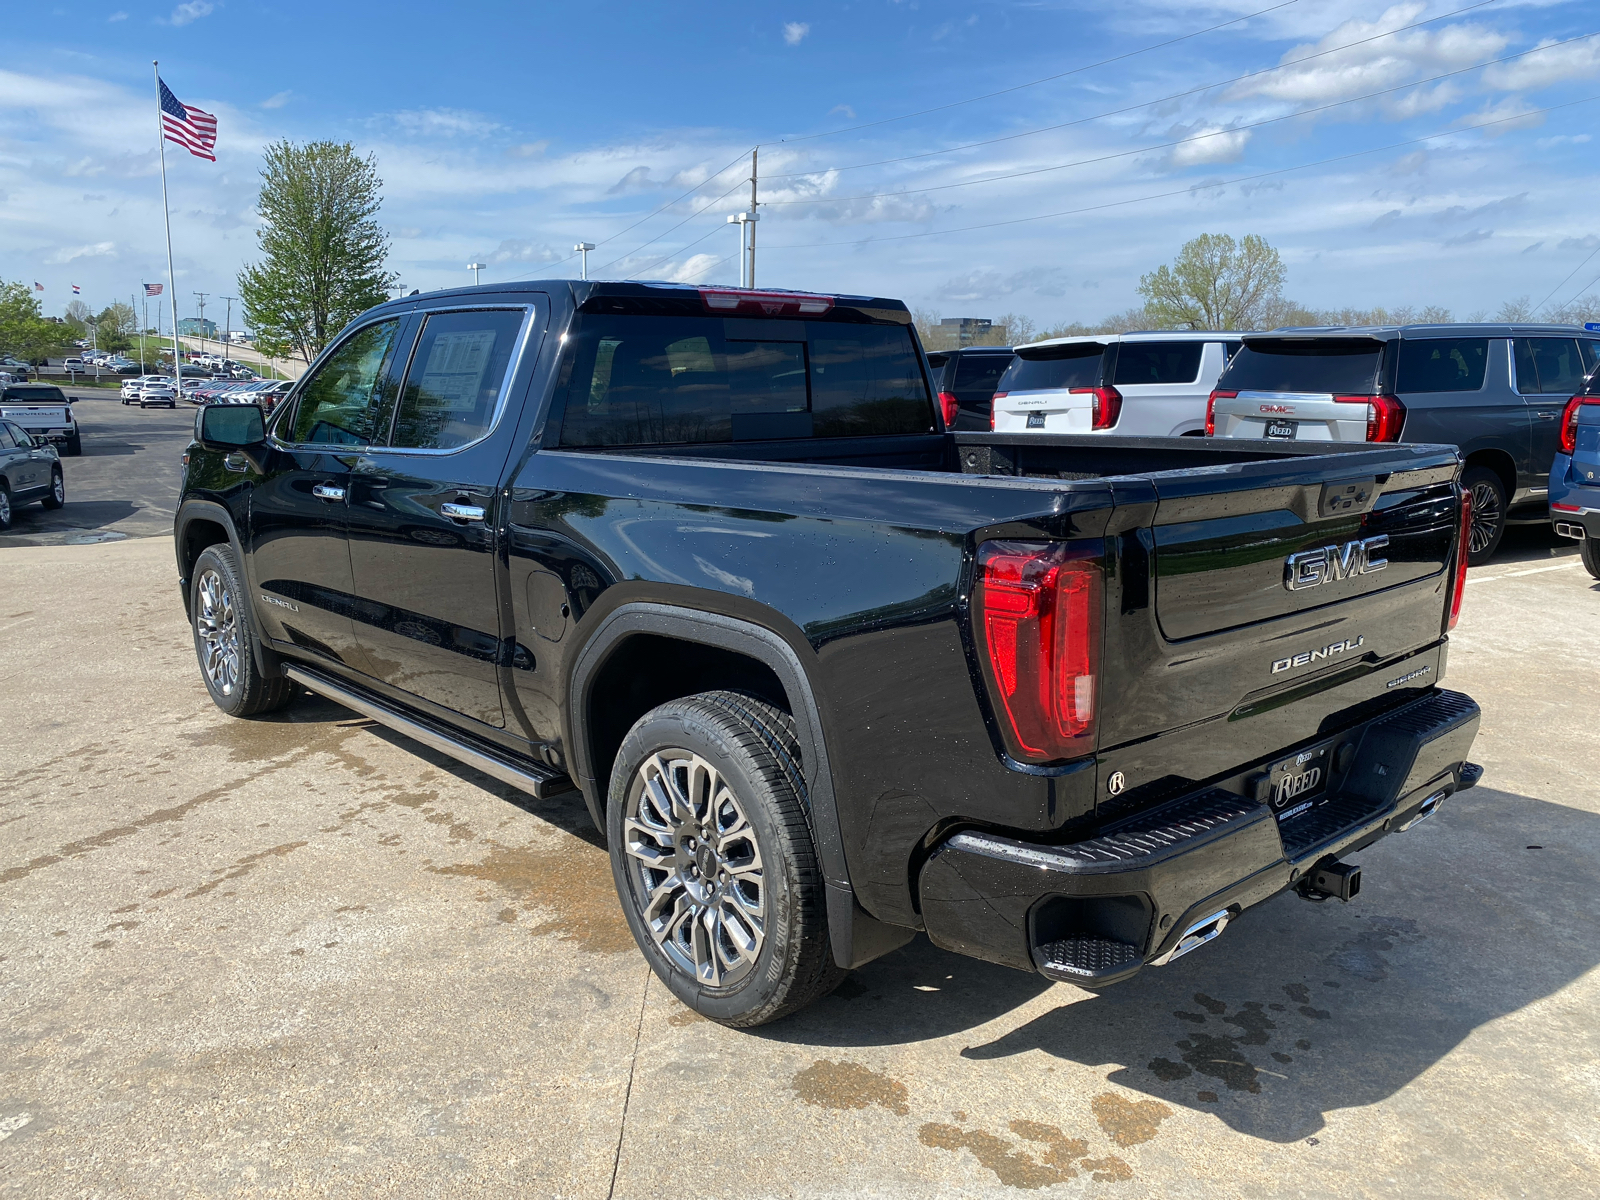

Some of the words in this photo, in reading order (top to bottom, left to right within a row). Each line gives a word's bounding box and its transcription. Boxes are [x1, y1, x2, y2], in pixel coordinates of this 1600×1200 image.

[1260, 404, 1296, 415] GMC
[1269, 424, 1292, 436] REED
[1283, 534, 1390, 592] GMC
[261, 594, 300, 613] DENALI
[1271, 634, 1364, 674] DENALI
[1387, 665, 1431, 689] SIERRA
[1275, 767, 1321, 808] REED
